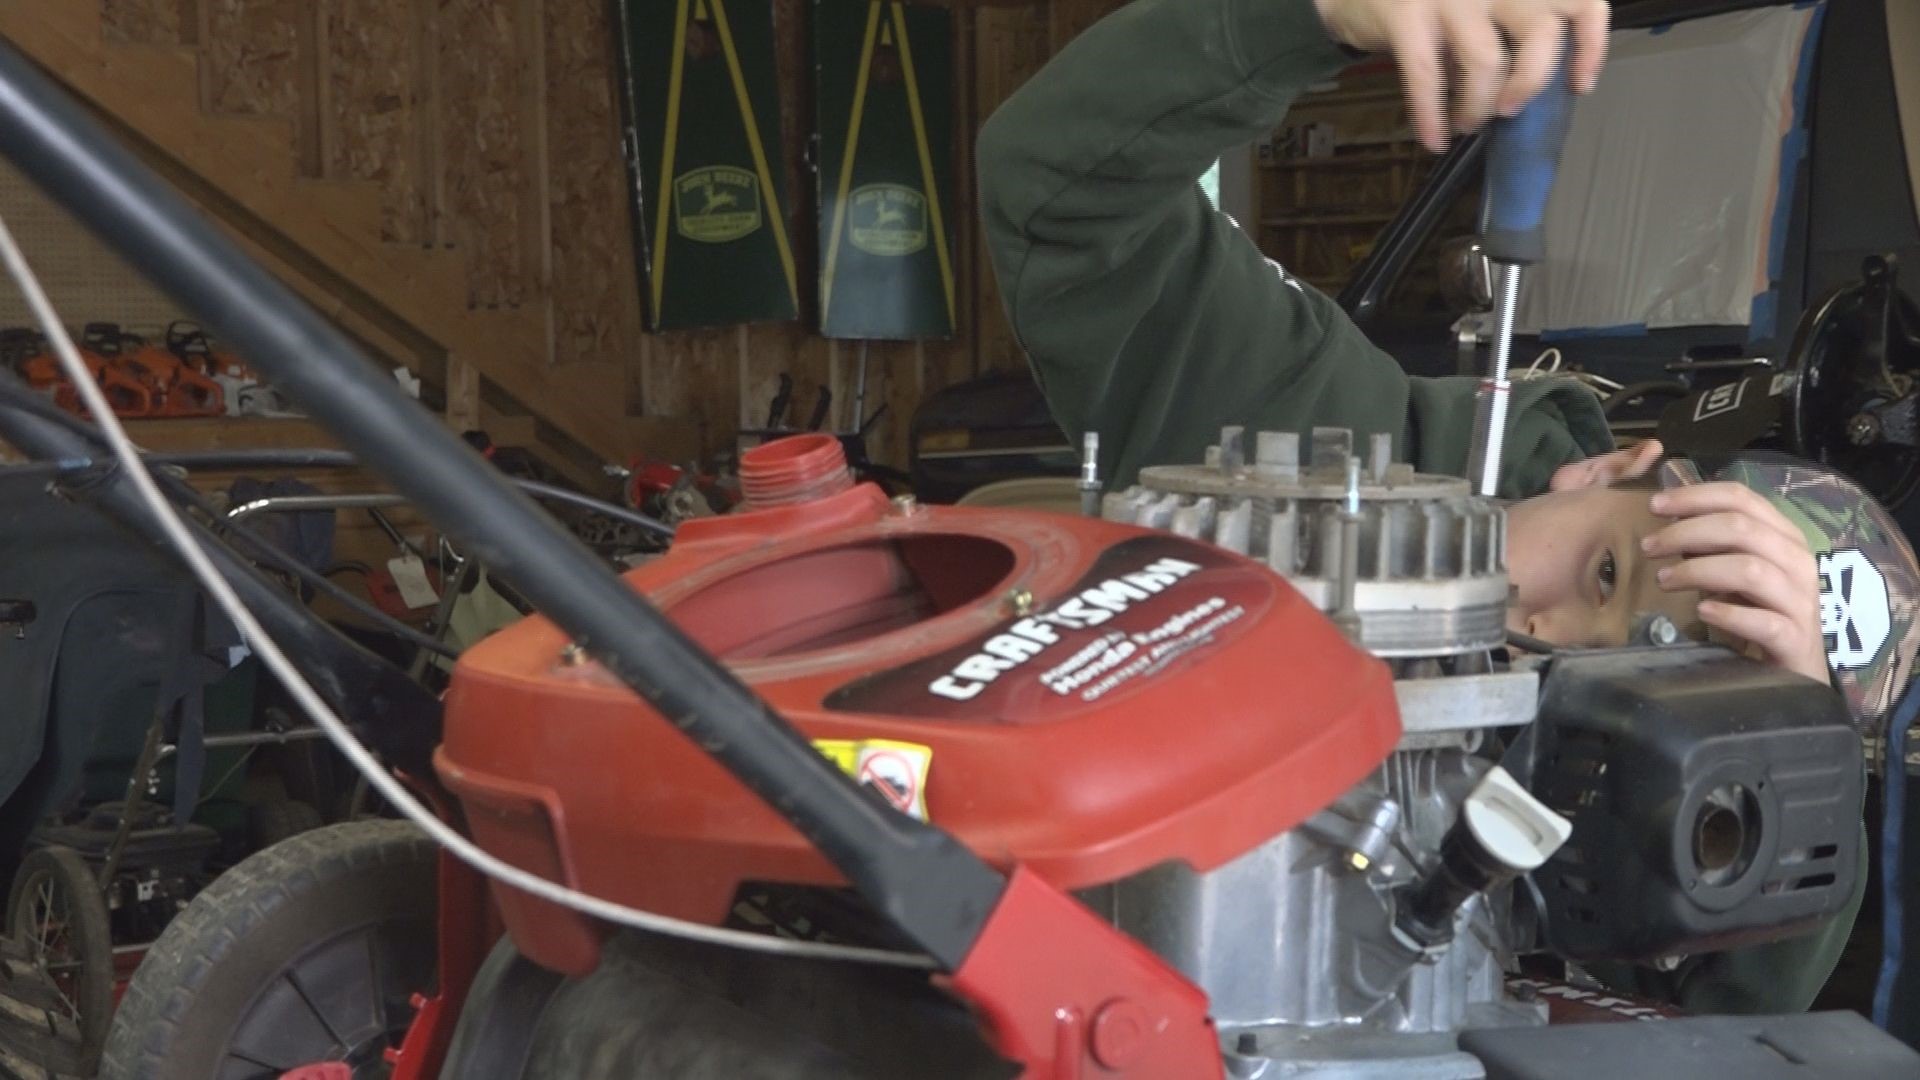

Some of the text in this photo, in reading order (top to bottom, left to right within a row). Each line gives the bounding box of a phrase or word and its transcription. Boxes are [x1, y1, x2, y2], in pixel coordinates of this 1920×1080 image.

[929, 557, 1202, 700] CRAFTSMAN
[1051, 641, 1137, 695] Honda
[1131, 597, 1226, 645] Engines
